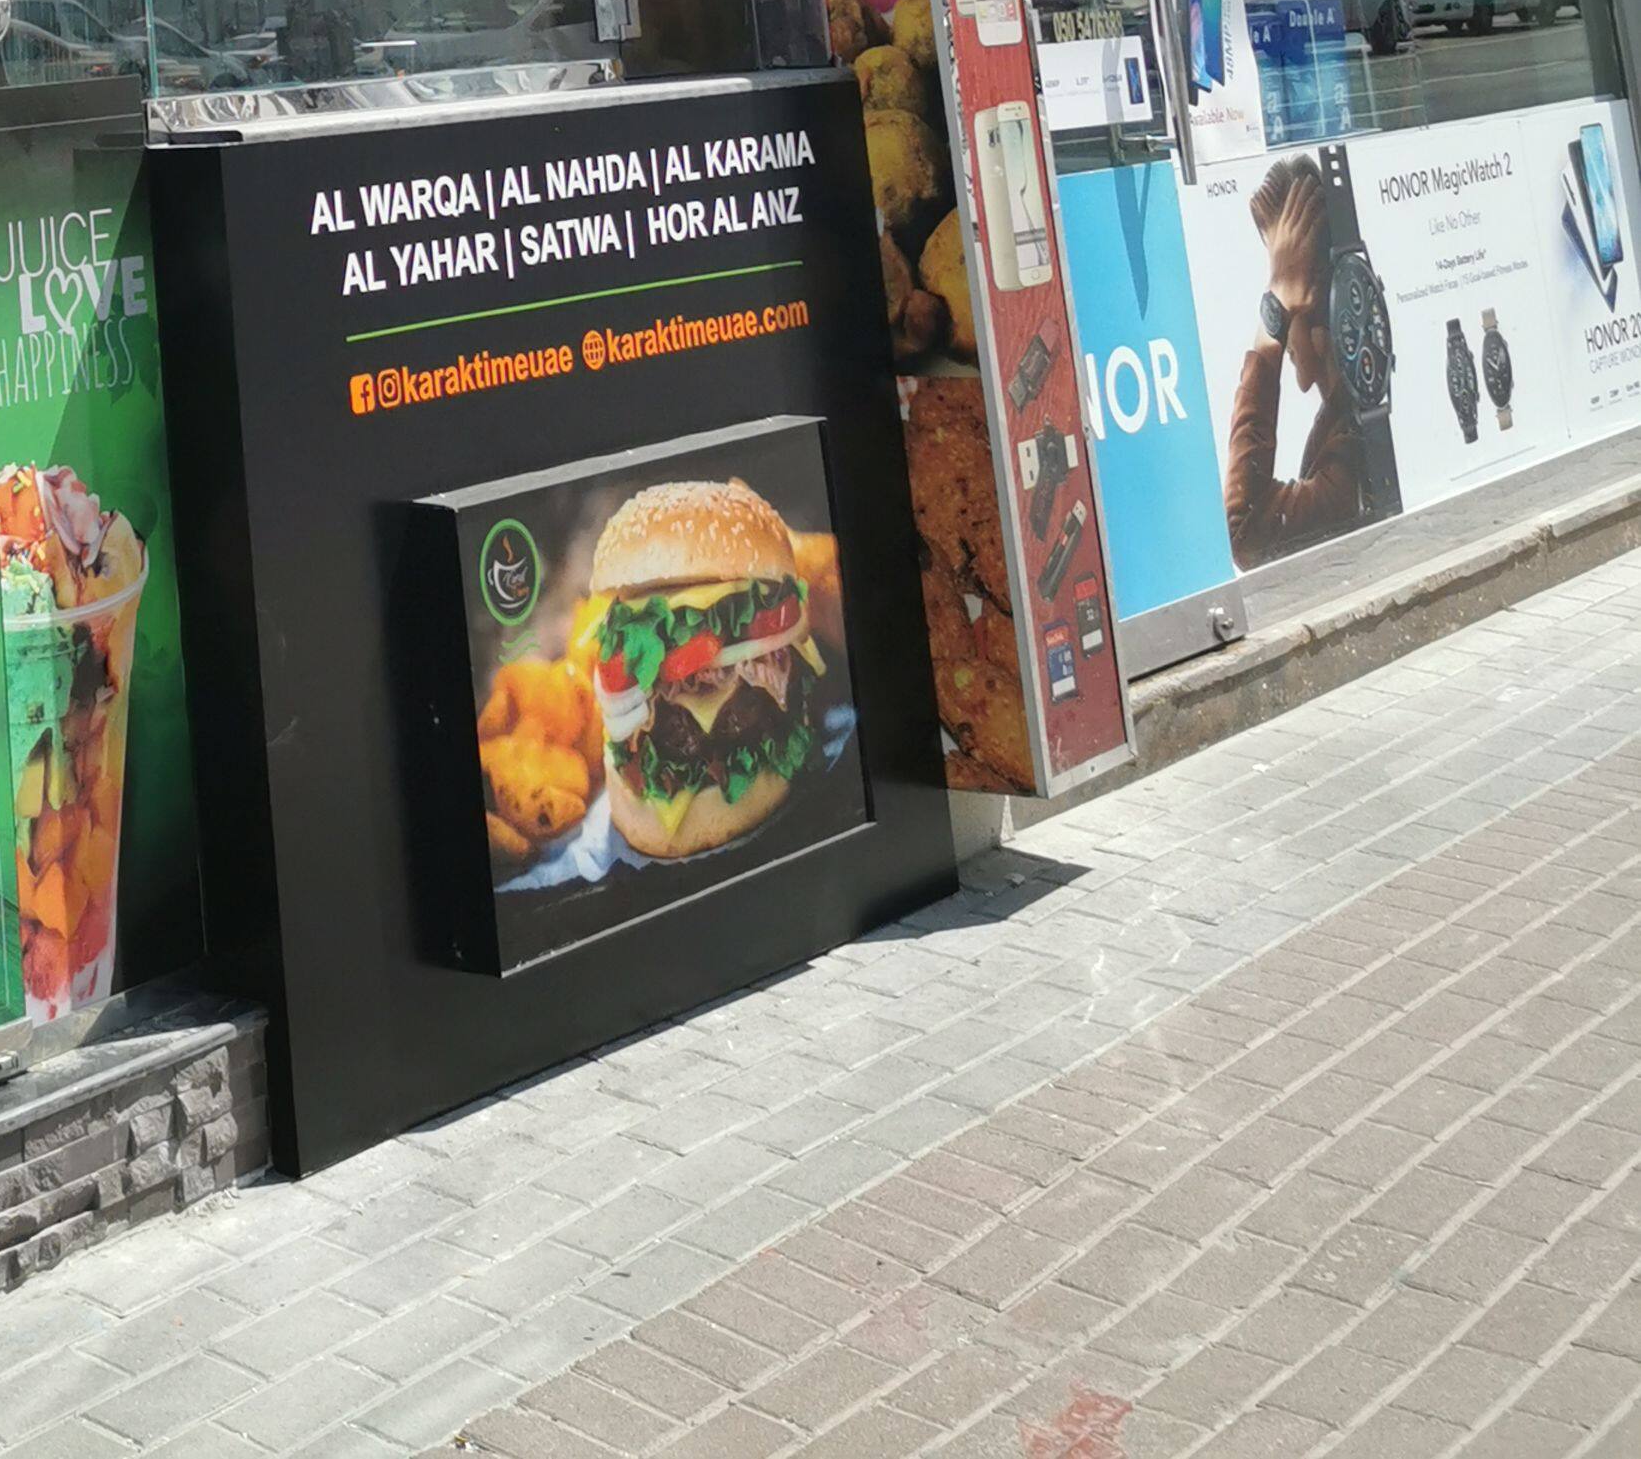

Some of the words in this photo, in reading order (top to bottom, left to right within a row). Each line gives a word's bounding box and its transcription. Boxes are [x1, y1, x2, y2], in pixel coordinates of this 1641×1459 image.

[310, 192, 355, 235] AL
[360, 173, 480, 228] WARQA
[501, 165, 541, 207] AL
[545, 151, 647, 201] NAHDA
[665, 145, 701, 184] AL
[704, 130, 816, 178] KARAMA
[1206, 179, 1238, 198] HONOR
[1379, 171, 1430, 204] HONOR
[1431, 153, 1504, 195] MagicWatch
[1503, 152, 1513, 176] 2
[342, 251, 386, 296] AL
[390, 232, 499, 286] YAHAR
[521, 212, 622, 265] SATWA
[648, 200, 707, 245] HOR
[713, 194, 747, 233] AL
[751, 186, 803, 230] ANZ
[1428, 217, 1445, 235] Like
[1446, 214, 1458, 230] No
[402, 343, 574, 405] karaktimeuae
[607, 299, 810, 364] karaktimeuae.com
[1584, 317, 1630, 354] HONOR
